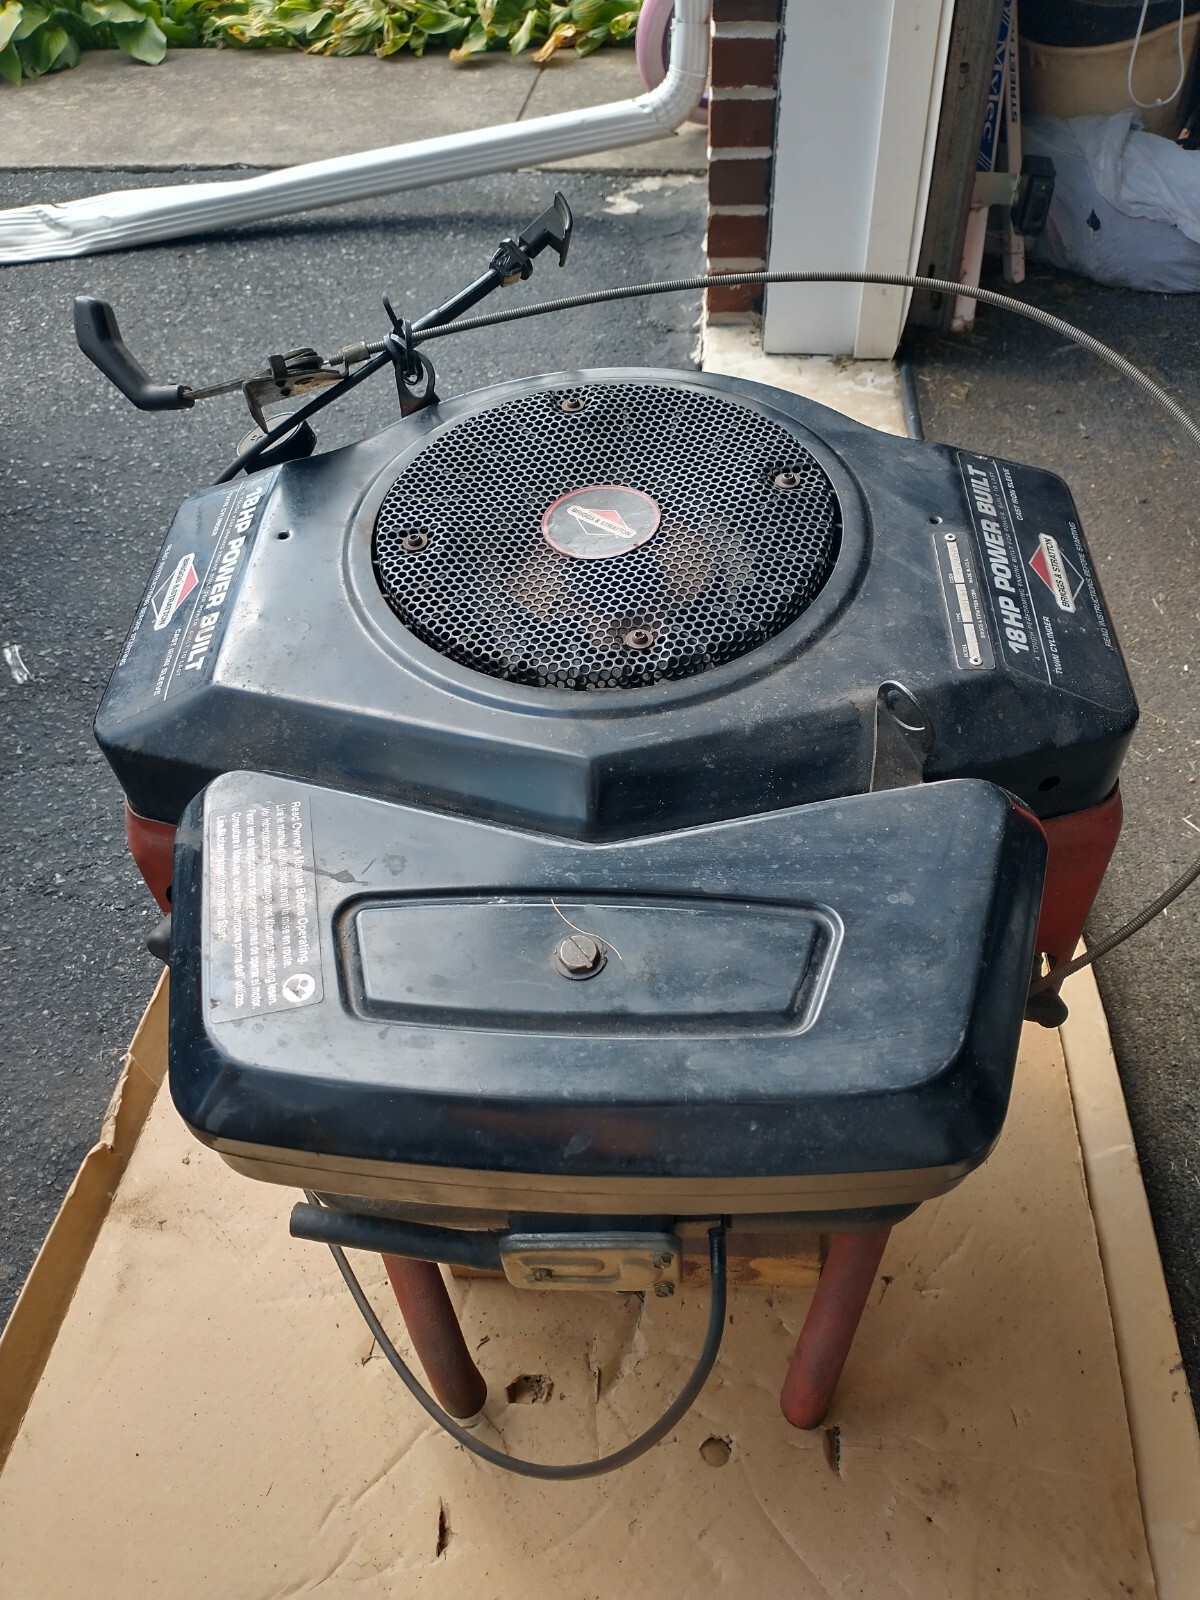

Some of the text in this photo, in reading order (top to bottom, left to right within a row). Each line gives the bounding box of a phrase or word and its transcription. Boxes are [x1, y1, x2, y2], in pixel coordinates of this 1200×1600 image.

[1009, 50, 1017, 123] STREET
[1001, 467, 1023, 520] CAST IRON SLEEVE
[211, 491, 233, 536] TWIN CYLINDER
[572, 508, 594, 521] BRIGGS
[600, 520, 631, 536] STRATTON
[967, 464, 1029, 653] 18HP POWER BUILT
[1043, 538, 1060, 572] STRATTON
[174, 557, 190, 583] BRIGGS
[185, 486, 263, 670] 18HP POWER BUILT
[1012, 564, 1023, 586] ENGINE
[1055, 579, 1070, 607] BRIGGS
[1068, 521, 1112, 647] READ INSTRUCTIONS BEFORE STARTING
[118, 544, 173, 666] READ INSTRUCTIONS BEFORE STARTING
[158, 589, 177, 625] STRATTON
[1018, 588, 1034, 629] PERFORMING
[1028, 631, 1039, 652] TOUGH
[1041, 615, 1063, 673] TWIN CYLINDER
[150, 628, 181, 700] CAST IRON SLEEVE
[174, 660, 184, 676] LAST
[245, 809, 256, 825] Favor
[275, 803, 286, 816] Lire
[246, 825, 256, 836] leer
[246, 837, 257, 846] las
[276, 823, 287, 848] manuel
[248, 887, 258, 895] de
[290, 801, 310, 965] Read Owner's Manual Before Operating.
[217, 898, 227, 919] innan
[279, 888, 289, 906] avant
[217, 919, 228, 940] Start.
[249, 927, 259, 945] antes
[281, 916, 291, 933] mise
[249, 946, 260, 955] de
[282, 935, 290, 945] en
[231, 943, 243, 962] prima
[282, 945, 293, 968] route.
[247, 956, 259, 977] operar
[234, 980, 245, 1008] utilizzo.
[250, 986, 261, 1009] motor.
[267, 983, 278, 1005] lesen.
